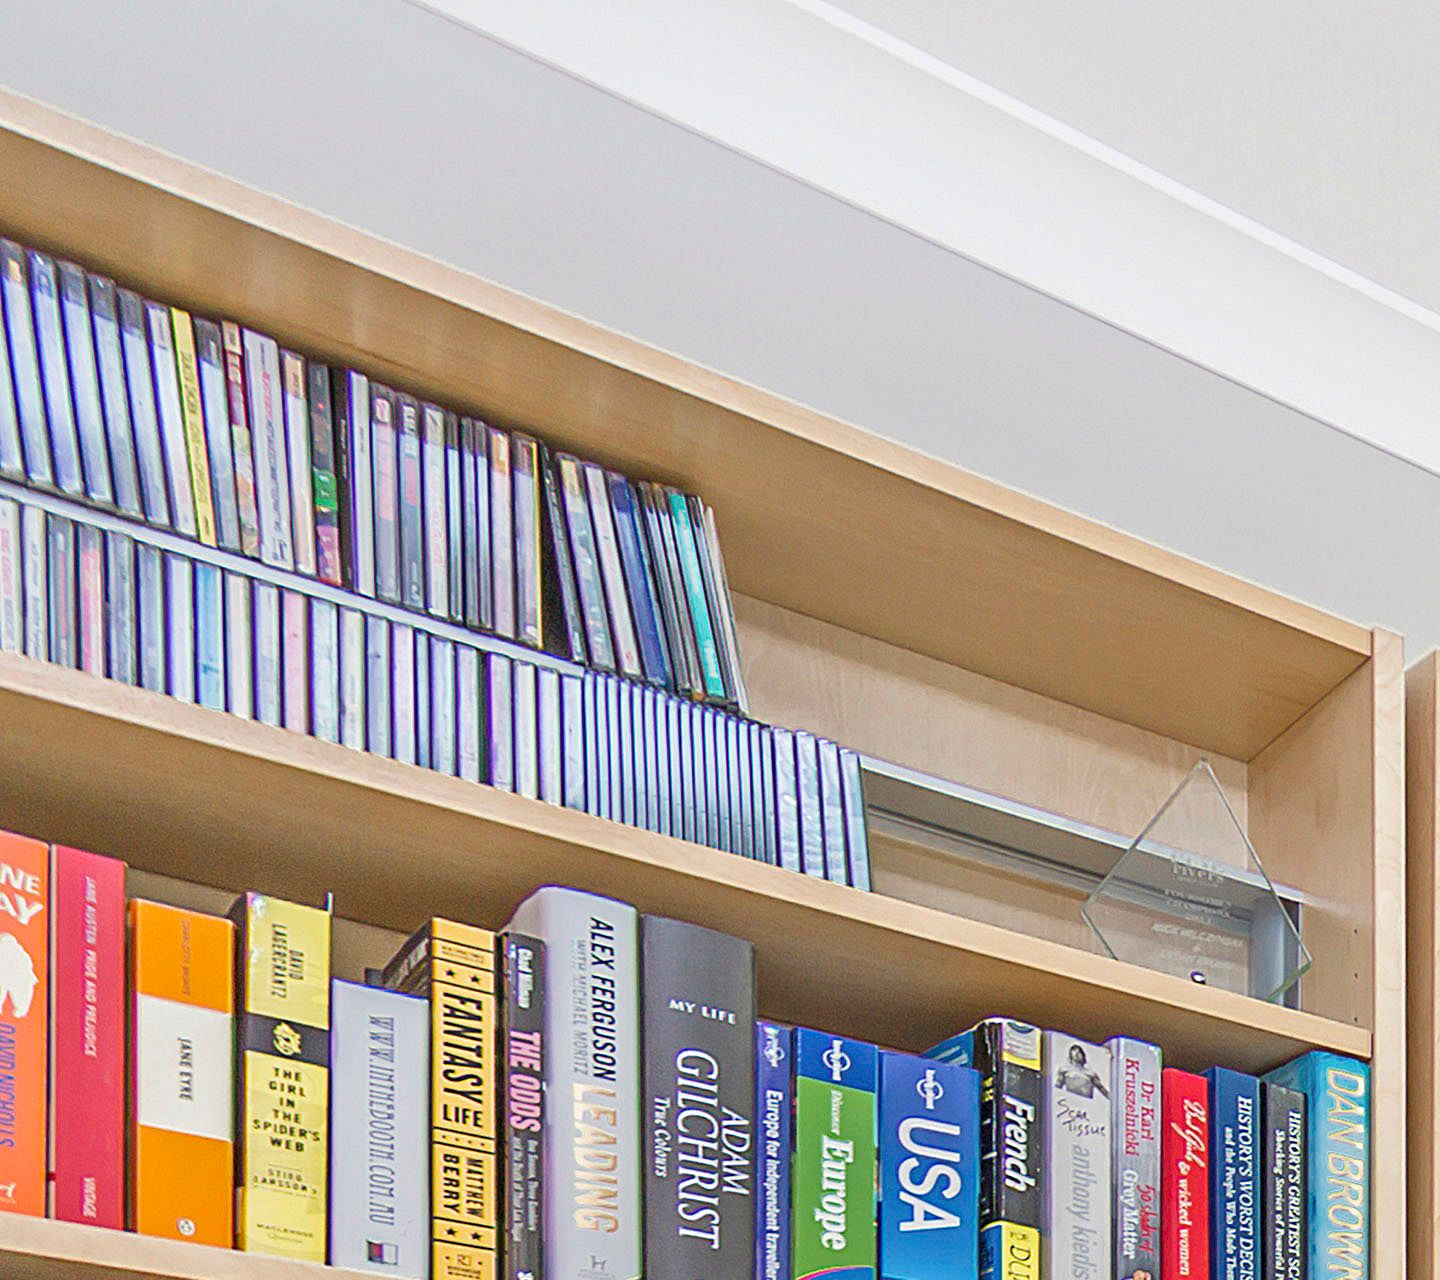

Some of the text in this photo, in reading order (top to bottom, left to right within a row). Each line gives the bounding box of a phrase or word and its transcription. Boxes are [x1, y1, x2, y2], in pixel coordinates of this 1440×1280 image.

[590, 916, 616, 1082] ALEX FERGUSON
[669, 999, 737, 1026] MY LIFE
[273, 1067, 301, 1082] THE
[443, 992, 482, 1104] FANTASY
[269, 1081, 306, 1097] GIRL
[272, 1109, 301, 1124] THE
[279, 1098, 295, 1108] IN
[442, 1104, 483, 1128] LIFE
[1327, 1068, 1366, 1149] DAN
[253, 1119, 320, 1142] SPIDER'S
[269, 1136, 304, 1152] WEB
[572, 1081, 619, 1235] LEADING
[676, 1047, 720, 1249] GILCHRIST
[720, 1106, 751, 1196] ADAM
[1002, 1092, 1036, 1193] French
[443, 1154, 460, 1213] BERRY
[821, 1135, 854, 1251] Europe
[898, 1117, 962, 1232] USA
